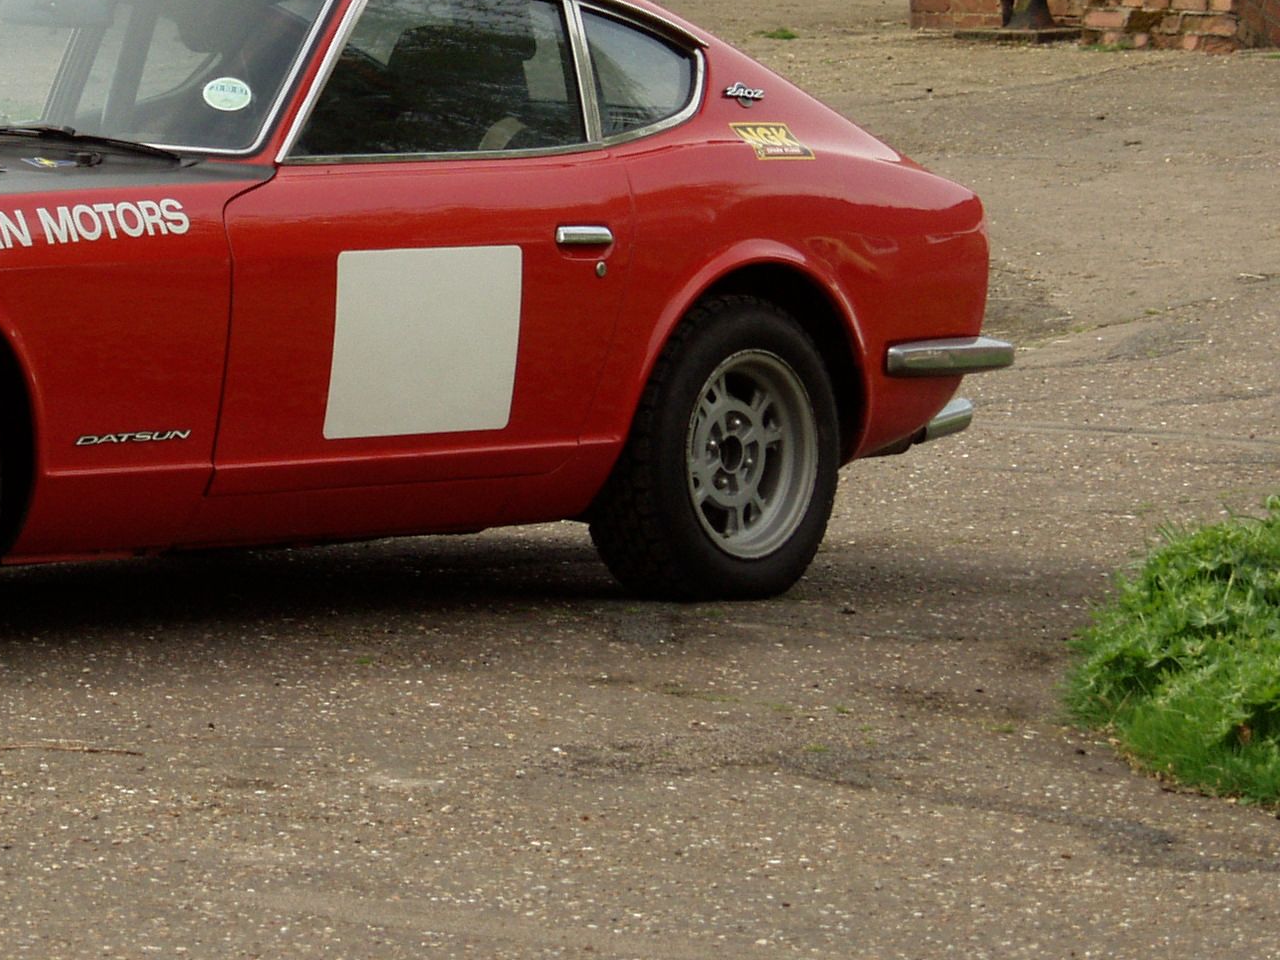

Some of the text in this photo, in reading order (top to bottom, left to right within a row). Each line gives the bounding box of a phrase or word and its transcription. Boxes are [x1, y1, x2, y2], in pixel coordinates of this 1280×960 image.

[735, 126, 800, 147] NGK
[36, 198, 190, 245] MOTORS
[75, 429, 192, 446] DATSUN
